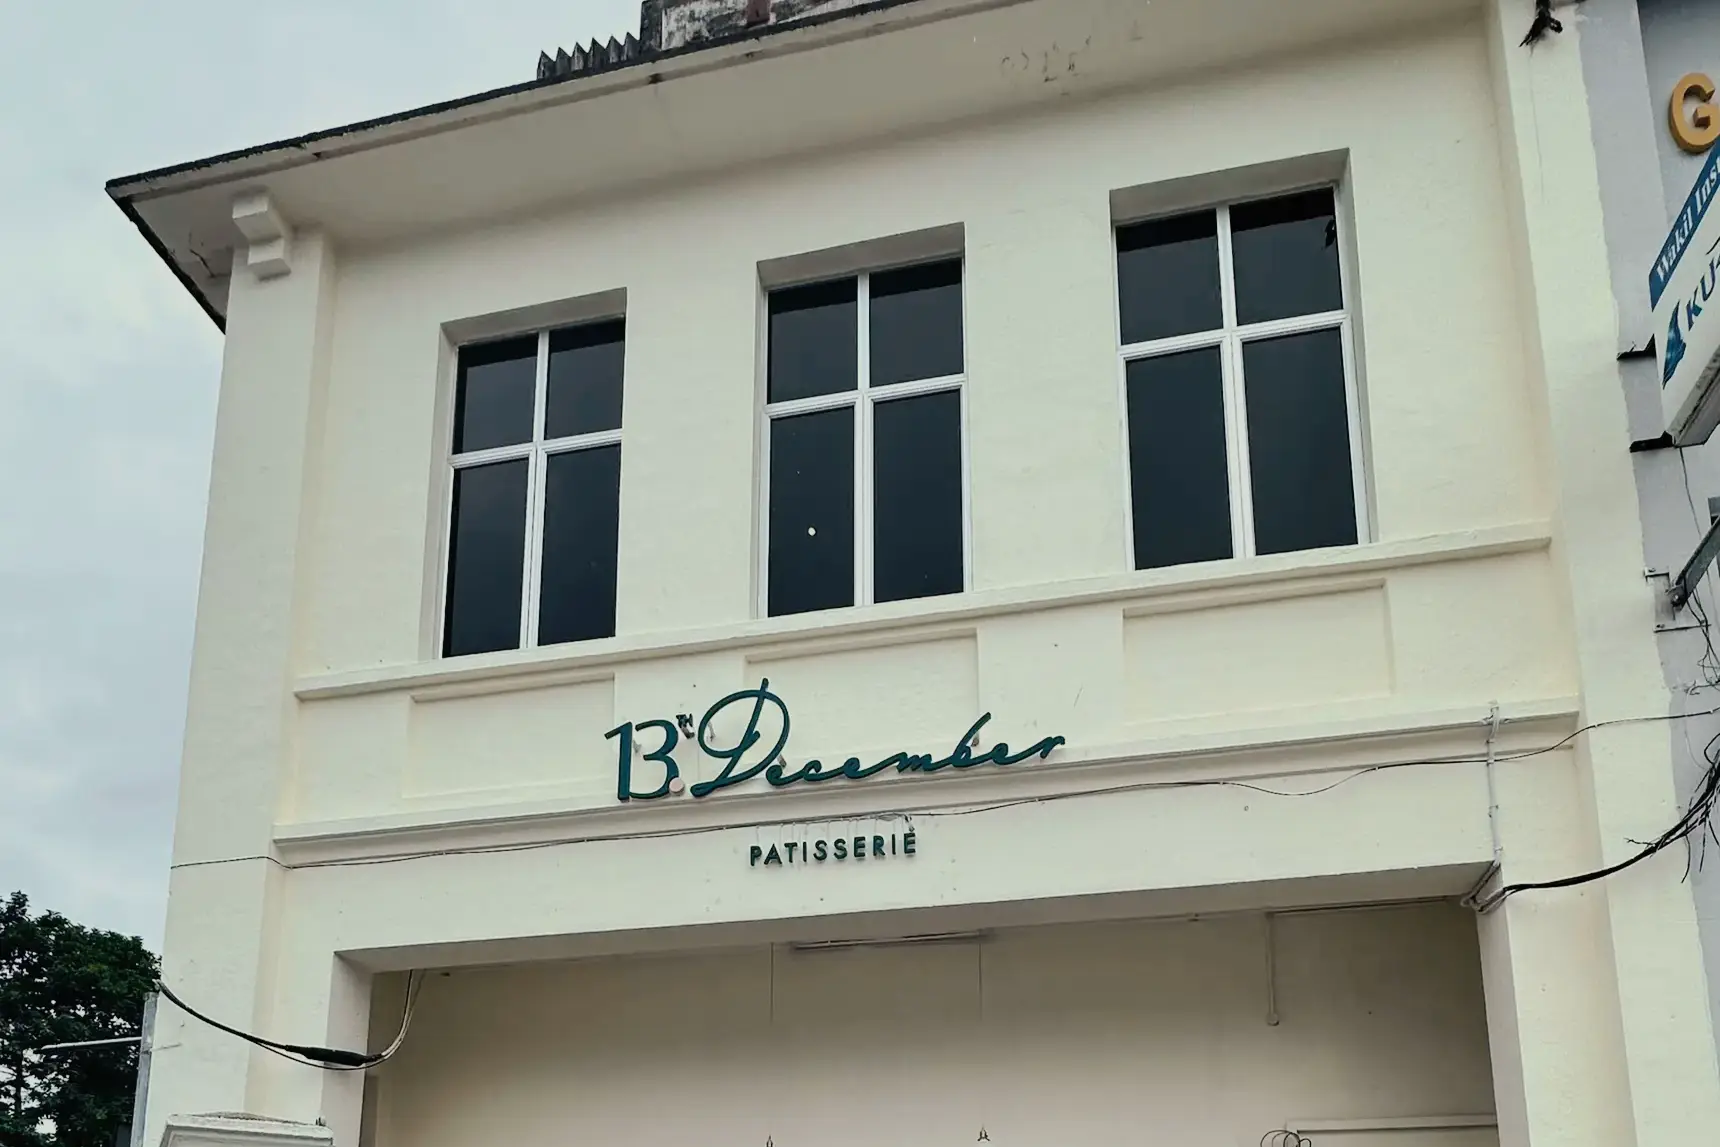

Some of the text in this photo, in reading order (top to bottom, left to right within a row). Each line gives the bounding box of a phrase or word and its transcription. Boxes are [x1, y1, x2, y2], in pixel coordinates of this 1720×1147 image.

[1656, 205, 1694, 282] Wakil
[1686, 252, 1720, 332] KU
[690, 677, 1066, 798] December
[750, 832, 916, 866] PATISSERIE
